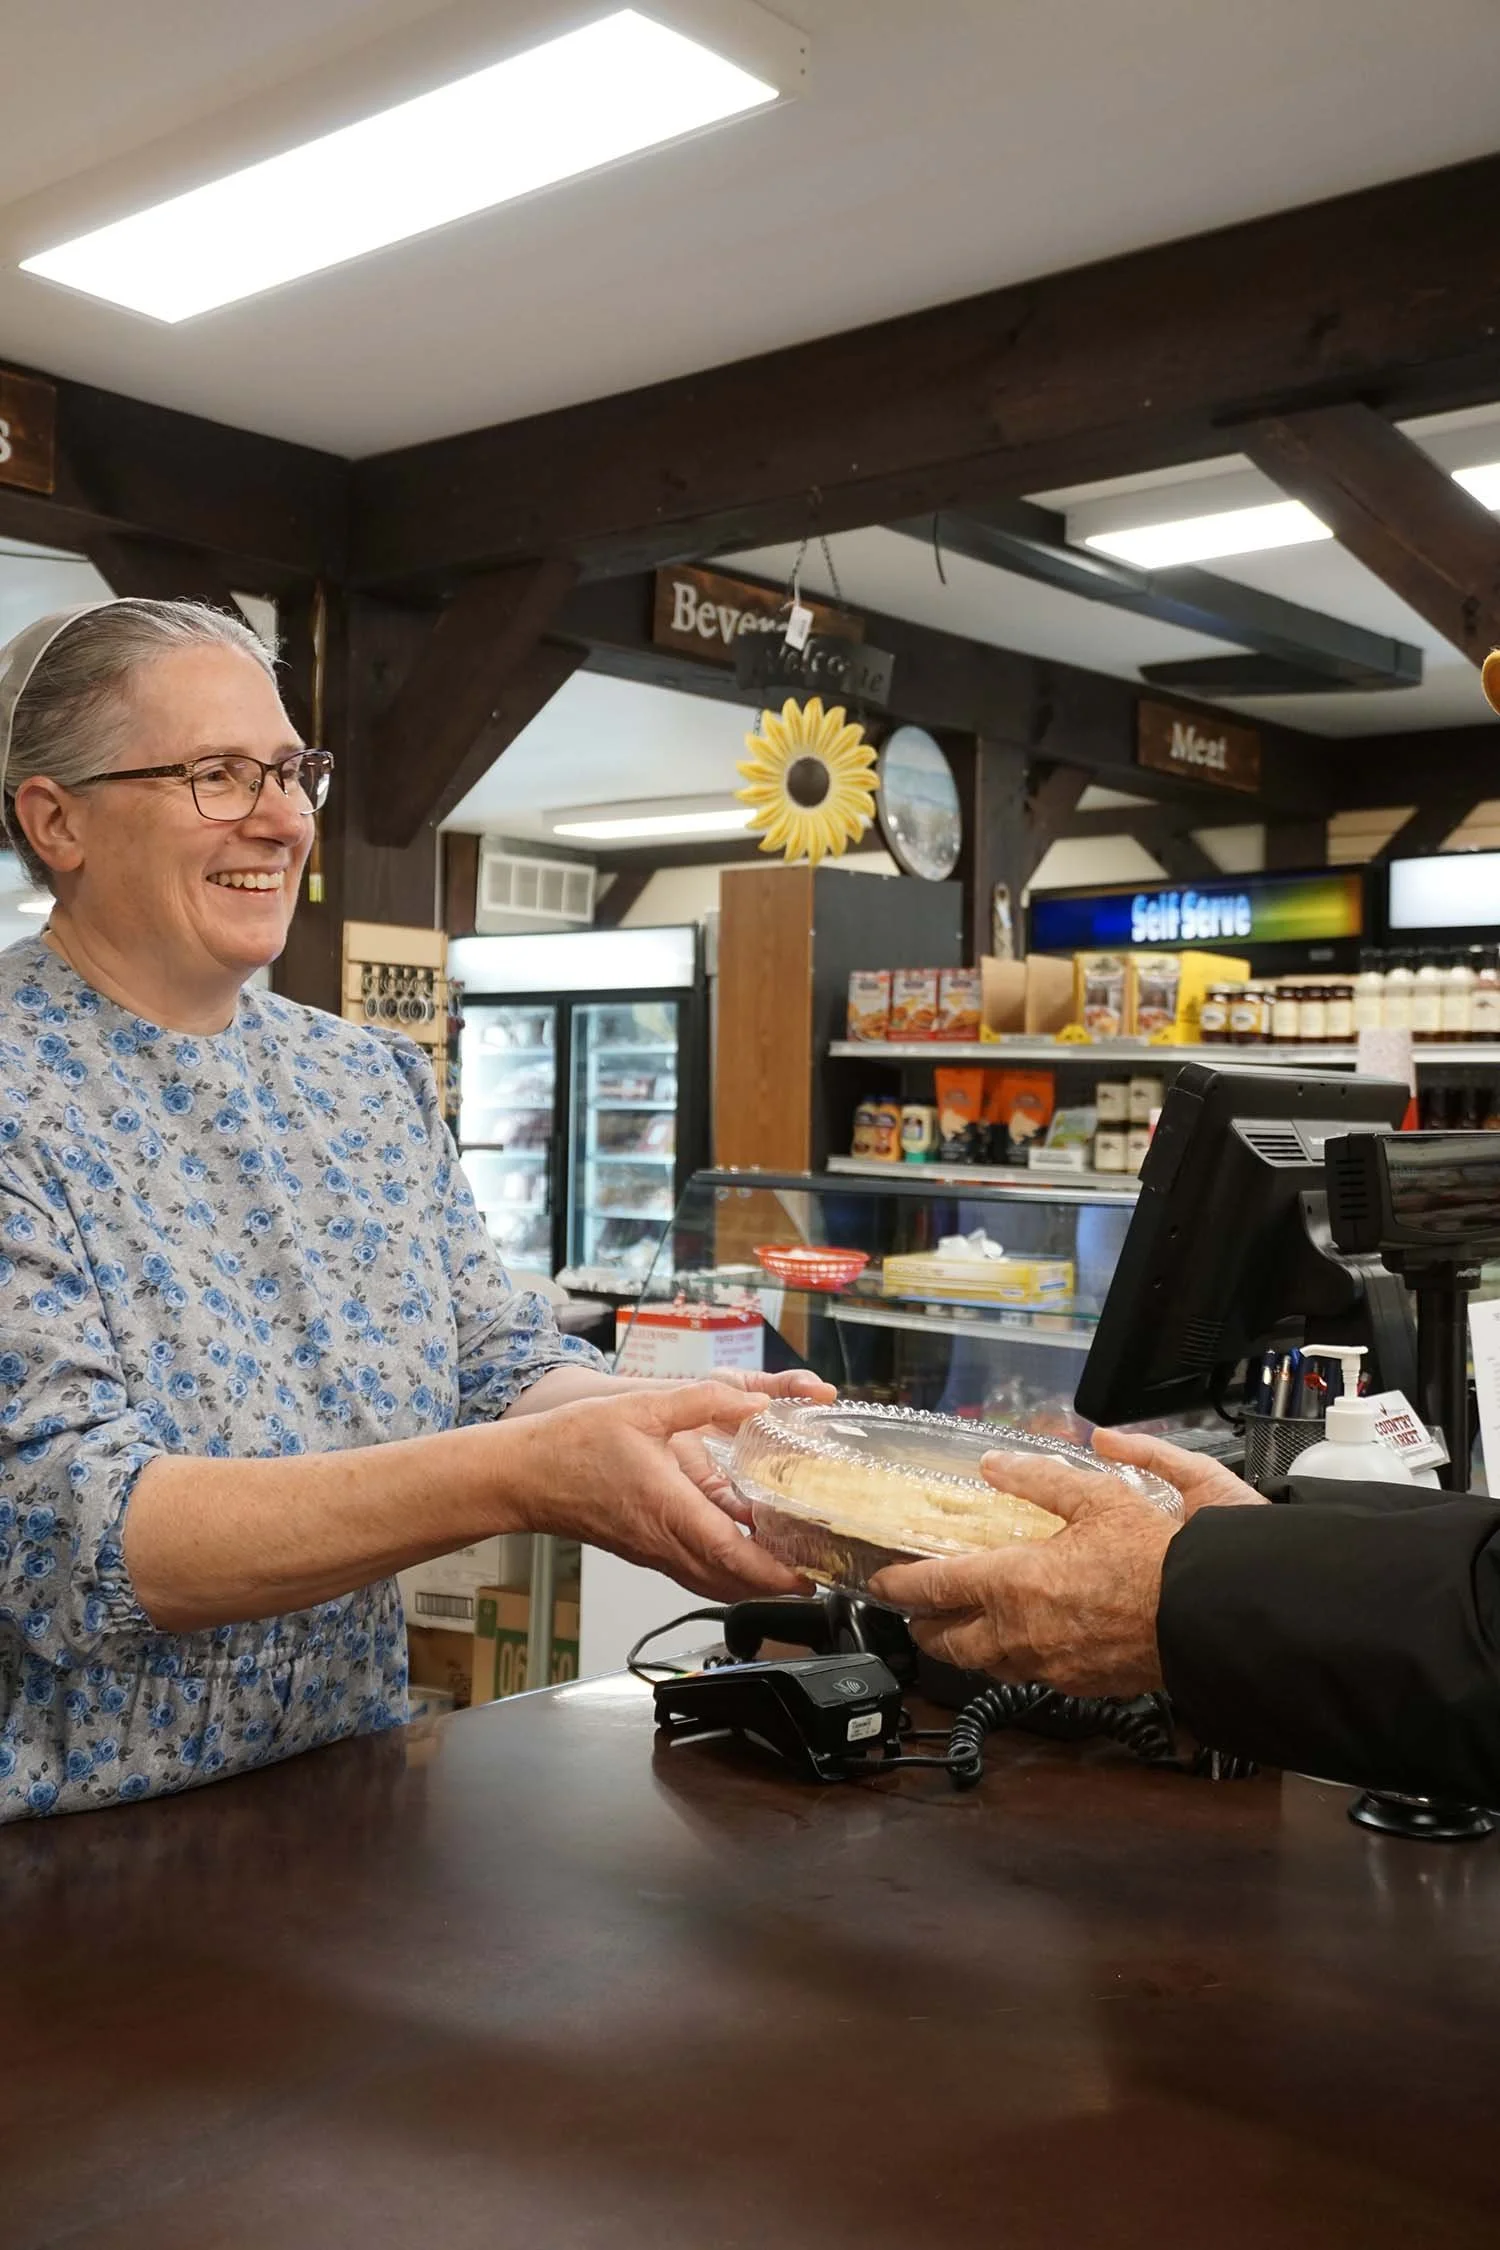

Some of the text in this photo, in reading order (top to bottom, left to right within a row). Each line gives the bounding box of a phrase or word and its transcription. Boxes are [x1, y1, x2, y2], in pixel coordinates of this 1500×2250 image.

[1170, 721, 1227, 770] Meat
[1131, 890, 1251, 942] Self Serve
[1374, 1414, 1415, 1436] COUNTRY
[1384, 1429, 1422, 1447] ARKET
